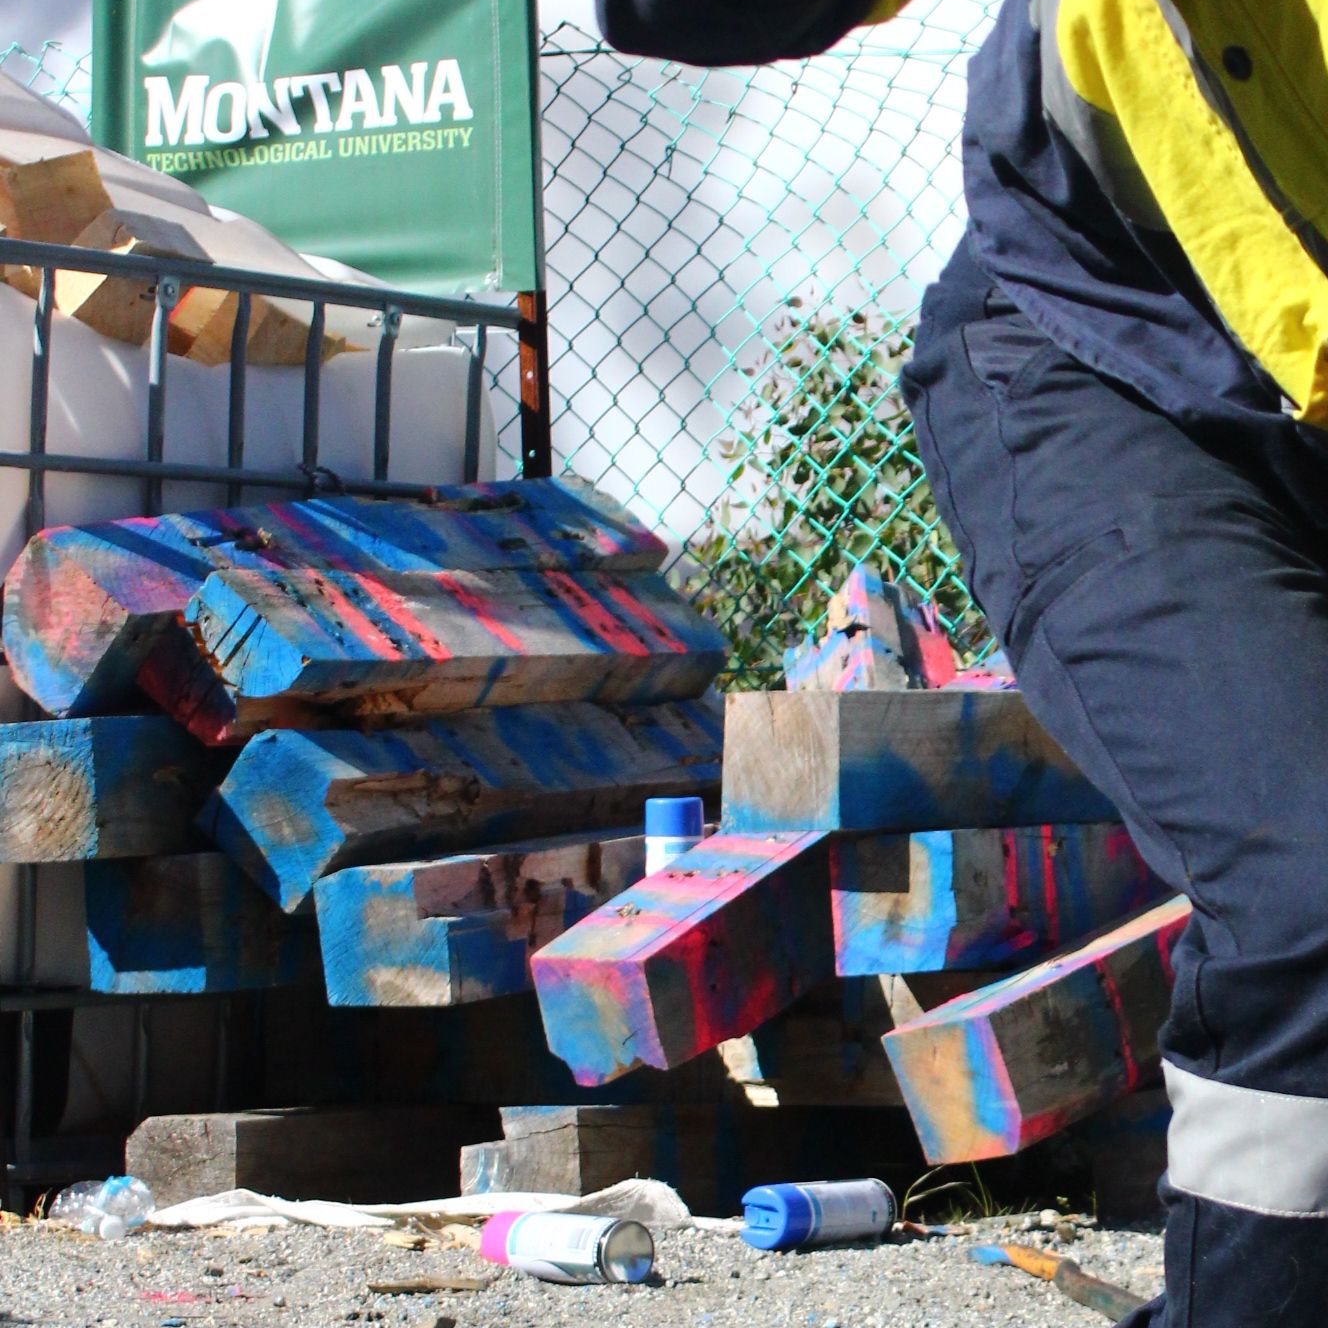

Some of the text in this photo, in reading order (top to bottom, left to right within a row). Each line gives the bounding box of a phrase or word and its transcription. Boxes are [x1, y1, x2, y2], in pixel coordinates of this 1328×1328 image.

[143, 58, 474, 147] MONTANA
[146, 127, 474, 173] TECHNOLOGICAL UNIVERSITY
